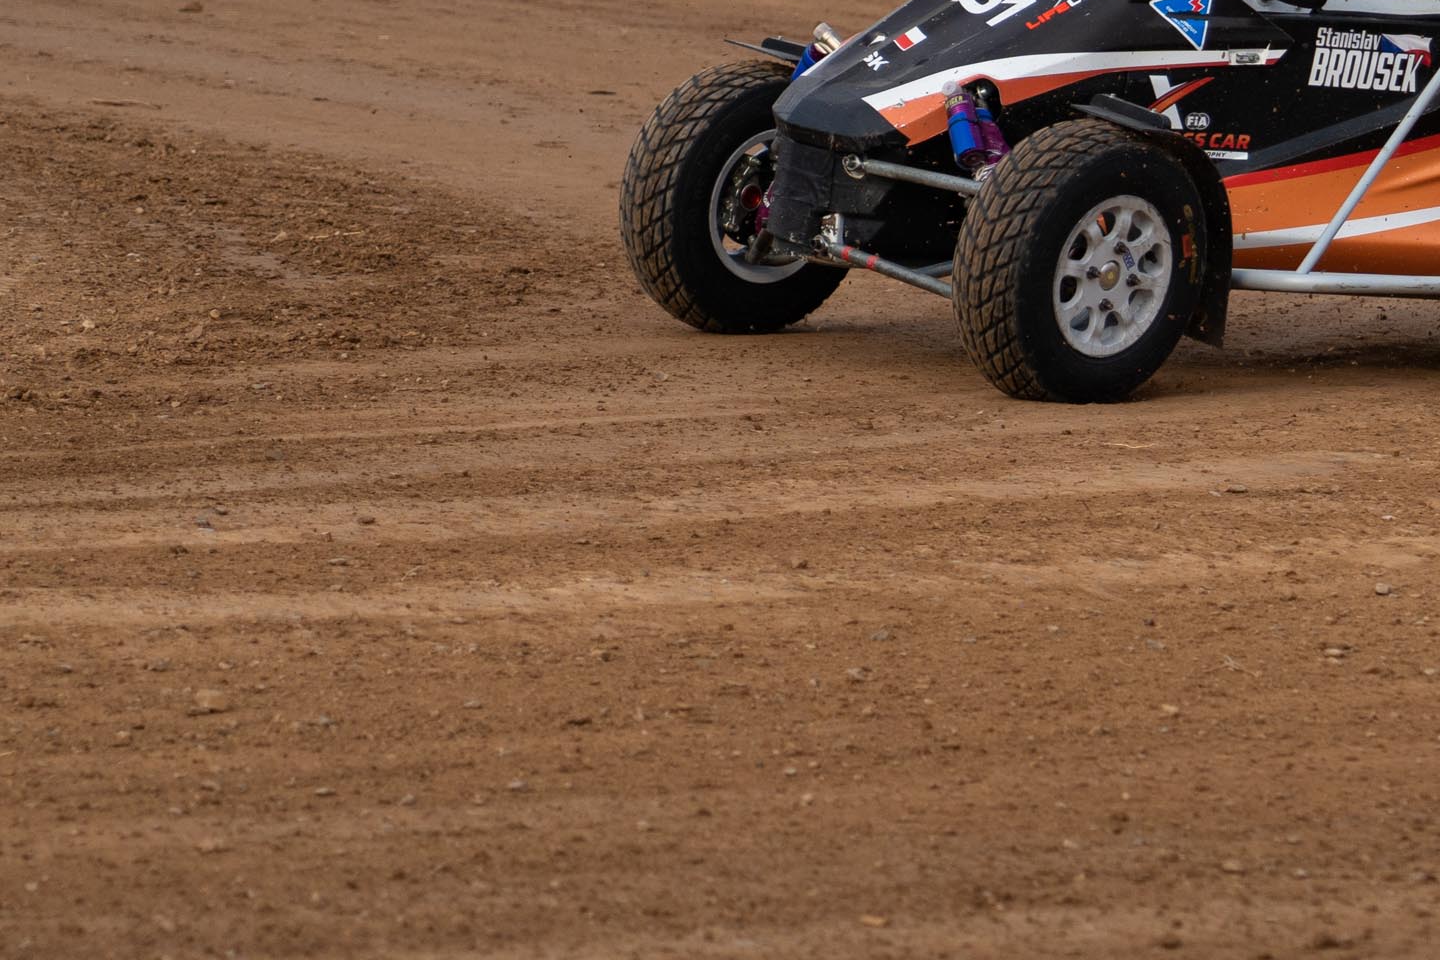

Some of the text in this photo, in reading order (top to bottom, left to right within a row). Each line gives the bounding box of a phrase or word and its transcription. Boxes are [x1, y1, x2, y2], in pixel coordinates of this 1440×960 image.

[1315, 27, 1381, 50] Stanislav
[1308, 47, 1423, 93] BROUSEK
[1209, 133, 1251, 149] CAR
